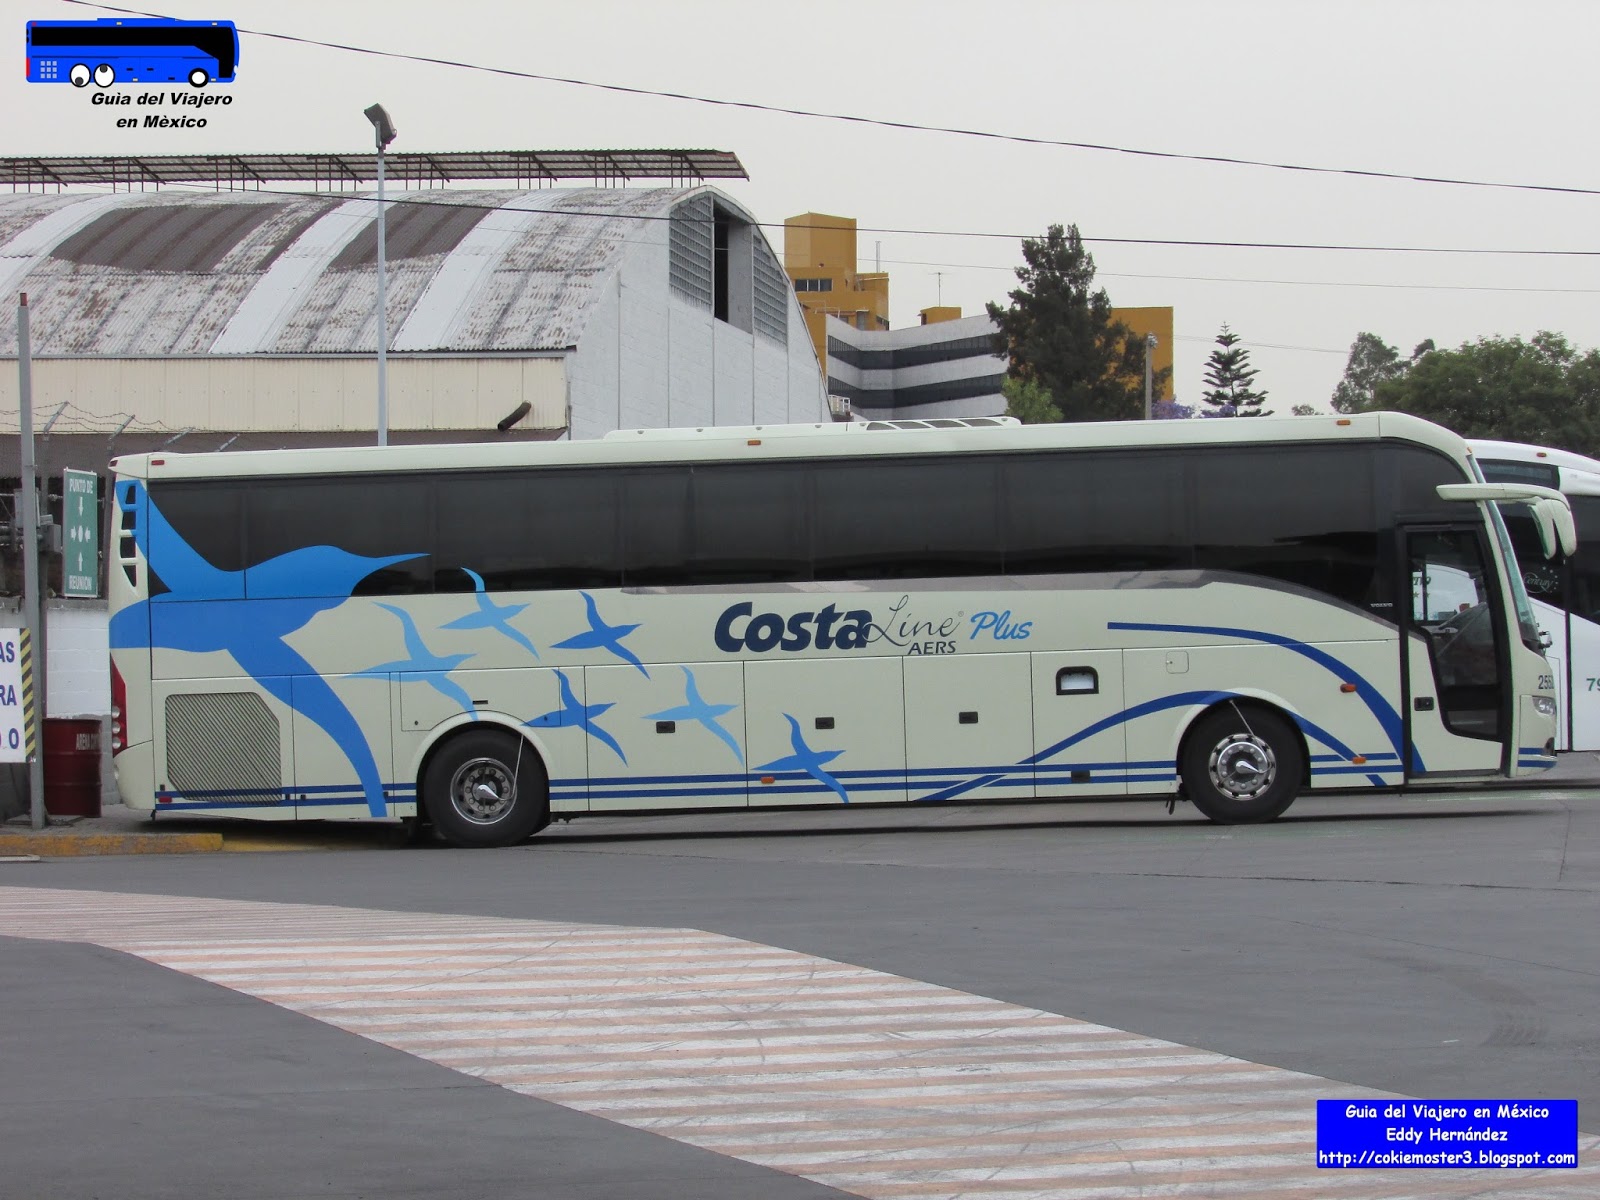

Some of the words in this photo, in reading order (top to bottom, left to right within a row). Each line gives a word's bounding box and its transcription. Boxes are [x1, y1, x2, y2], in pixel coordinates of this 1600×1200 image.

[69, 478, 87, 493] PUNTO
[86, 480, 93, 494] DE
[714, 601, 873, 653] Costa
[862, 594, 961, 648] Line
[969, 610, 1034, 641] Plus
[907, 640, 957, 656] AERS
